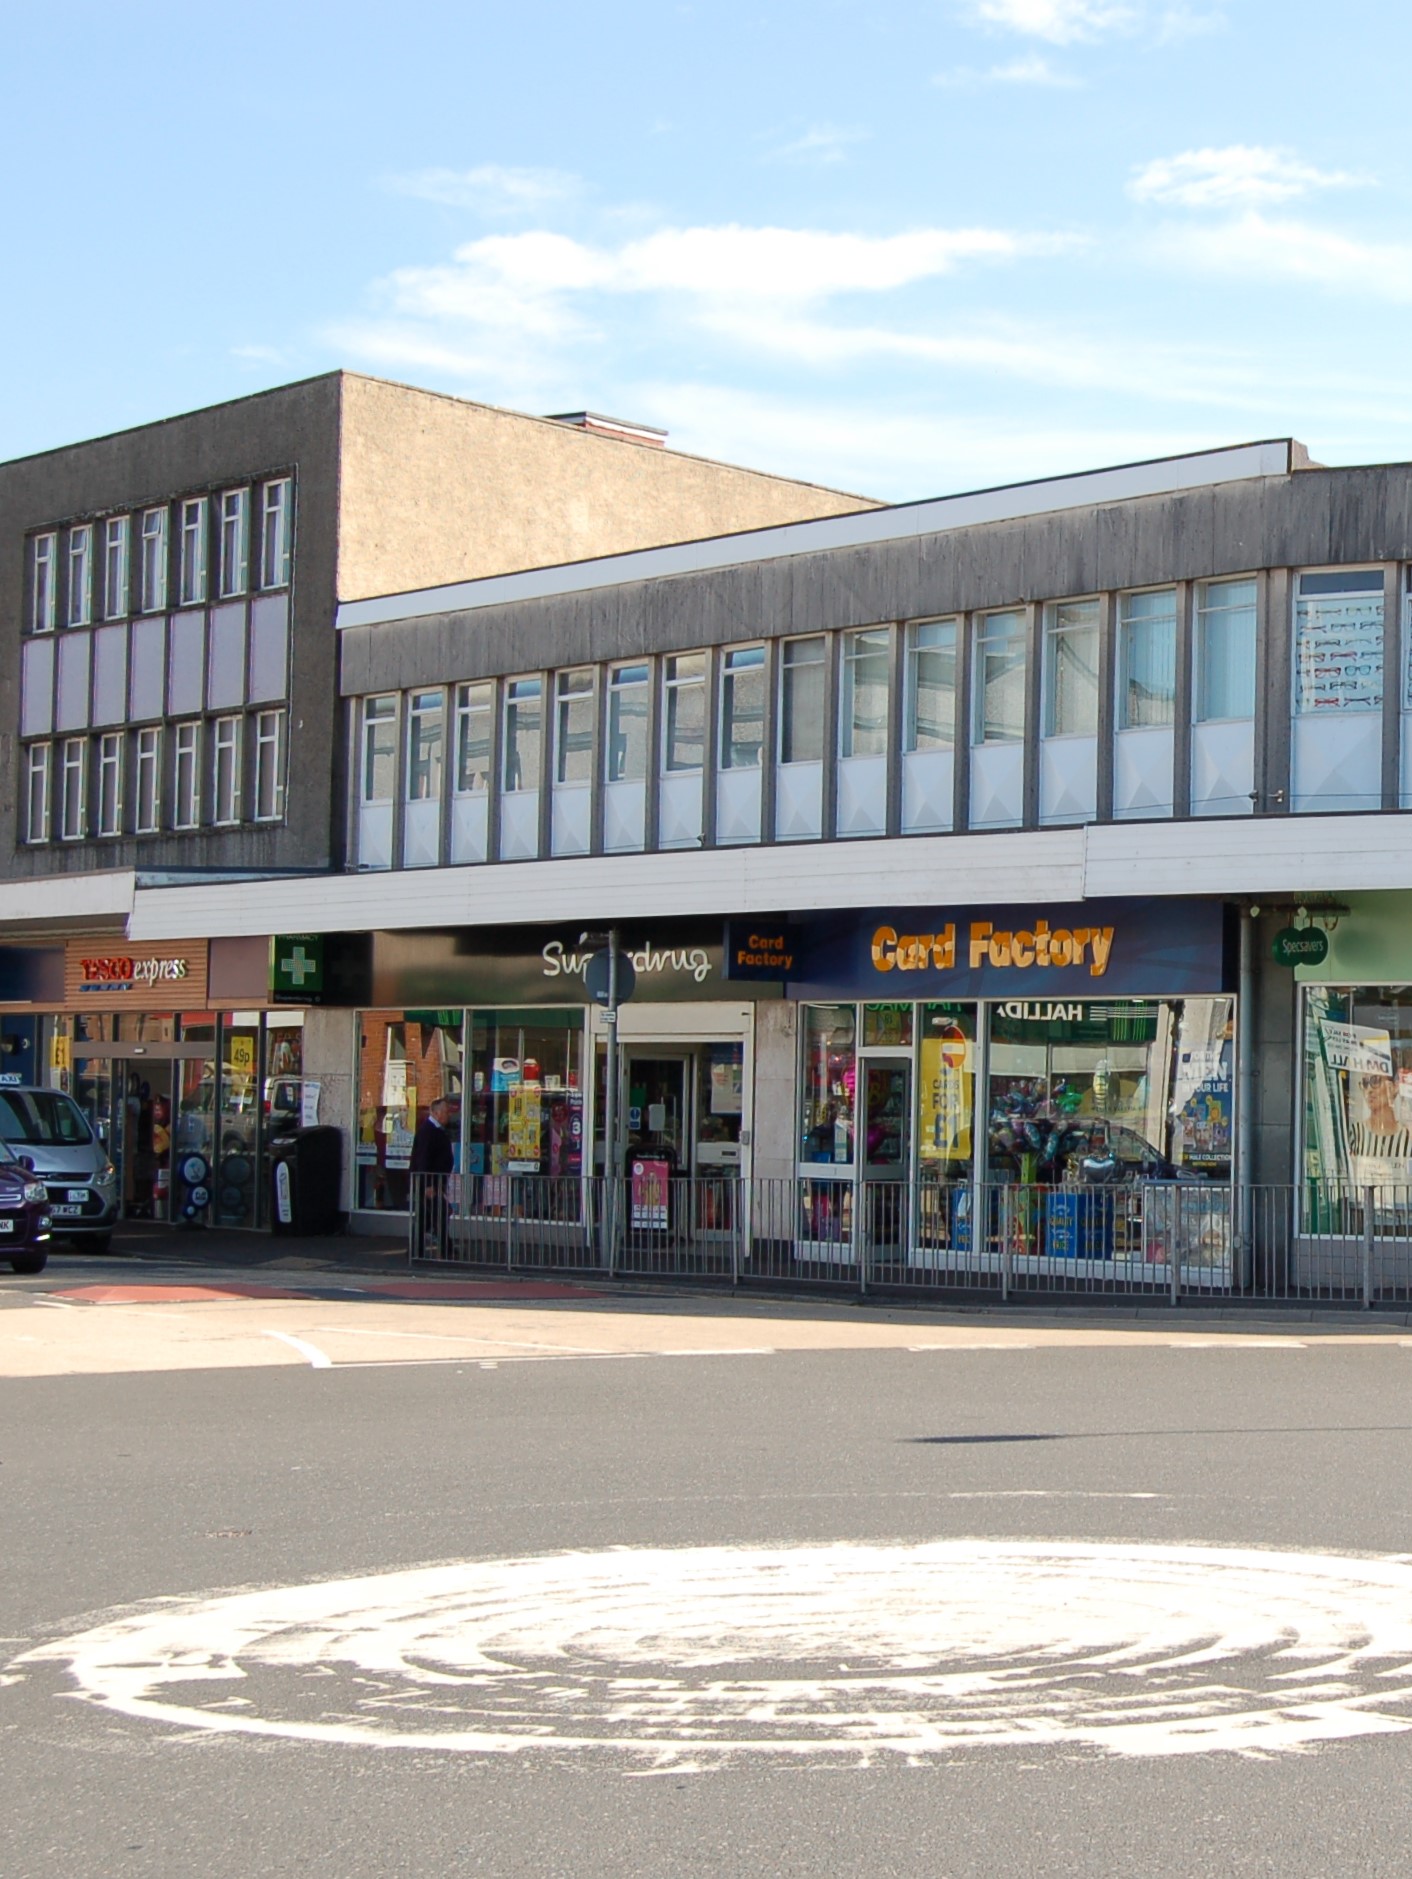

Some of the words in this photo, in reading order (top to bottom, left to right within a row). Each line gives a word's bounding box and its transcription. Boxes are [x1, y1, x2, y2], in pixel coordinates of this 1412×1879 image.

[749, 934, 784, 950] Card
[871, 922, 956, 972] Card
[969, 920, 1115, 976] Factory
[1282, 937, 1324, 955] Specsavers
[542, 940, 712, 983] Sudrug
[737, 951, 793, 969] Factory
[80, 956, 133, 981] TESCO
[133, 956, 188, 988] express
[233, 1048, 250, 1066] 49p
[0, 1075, 19, 1084] AXI
[1212, 1082, 1230, 1094] LIFE
